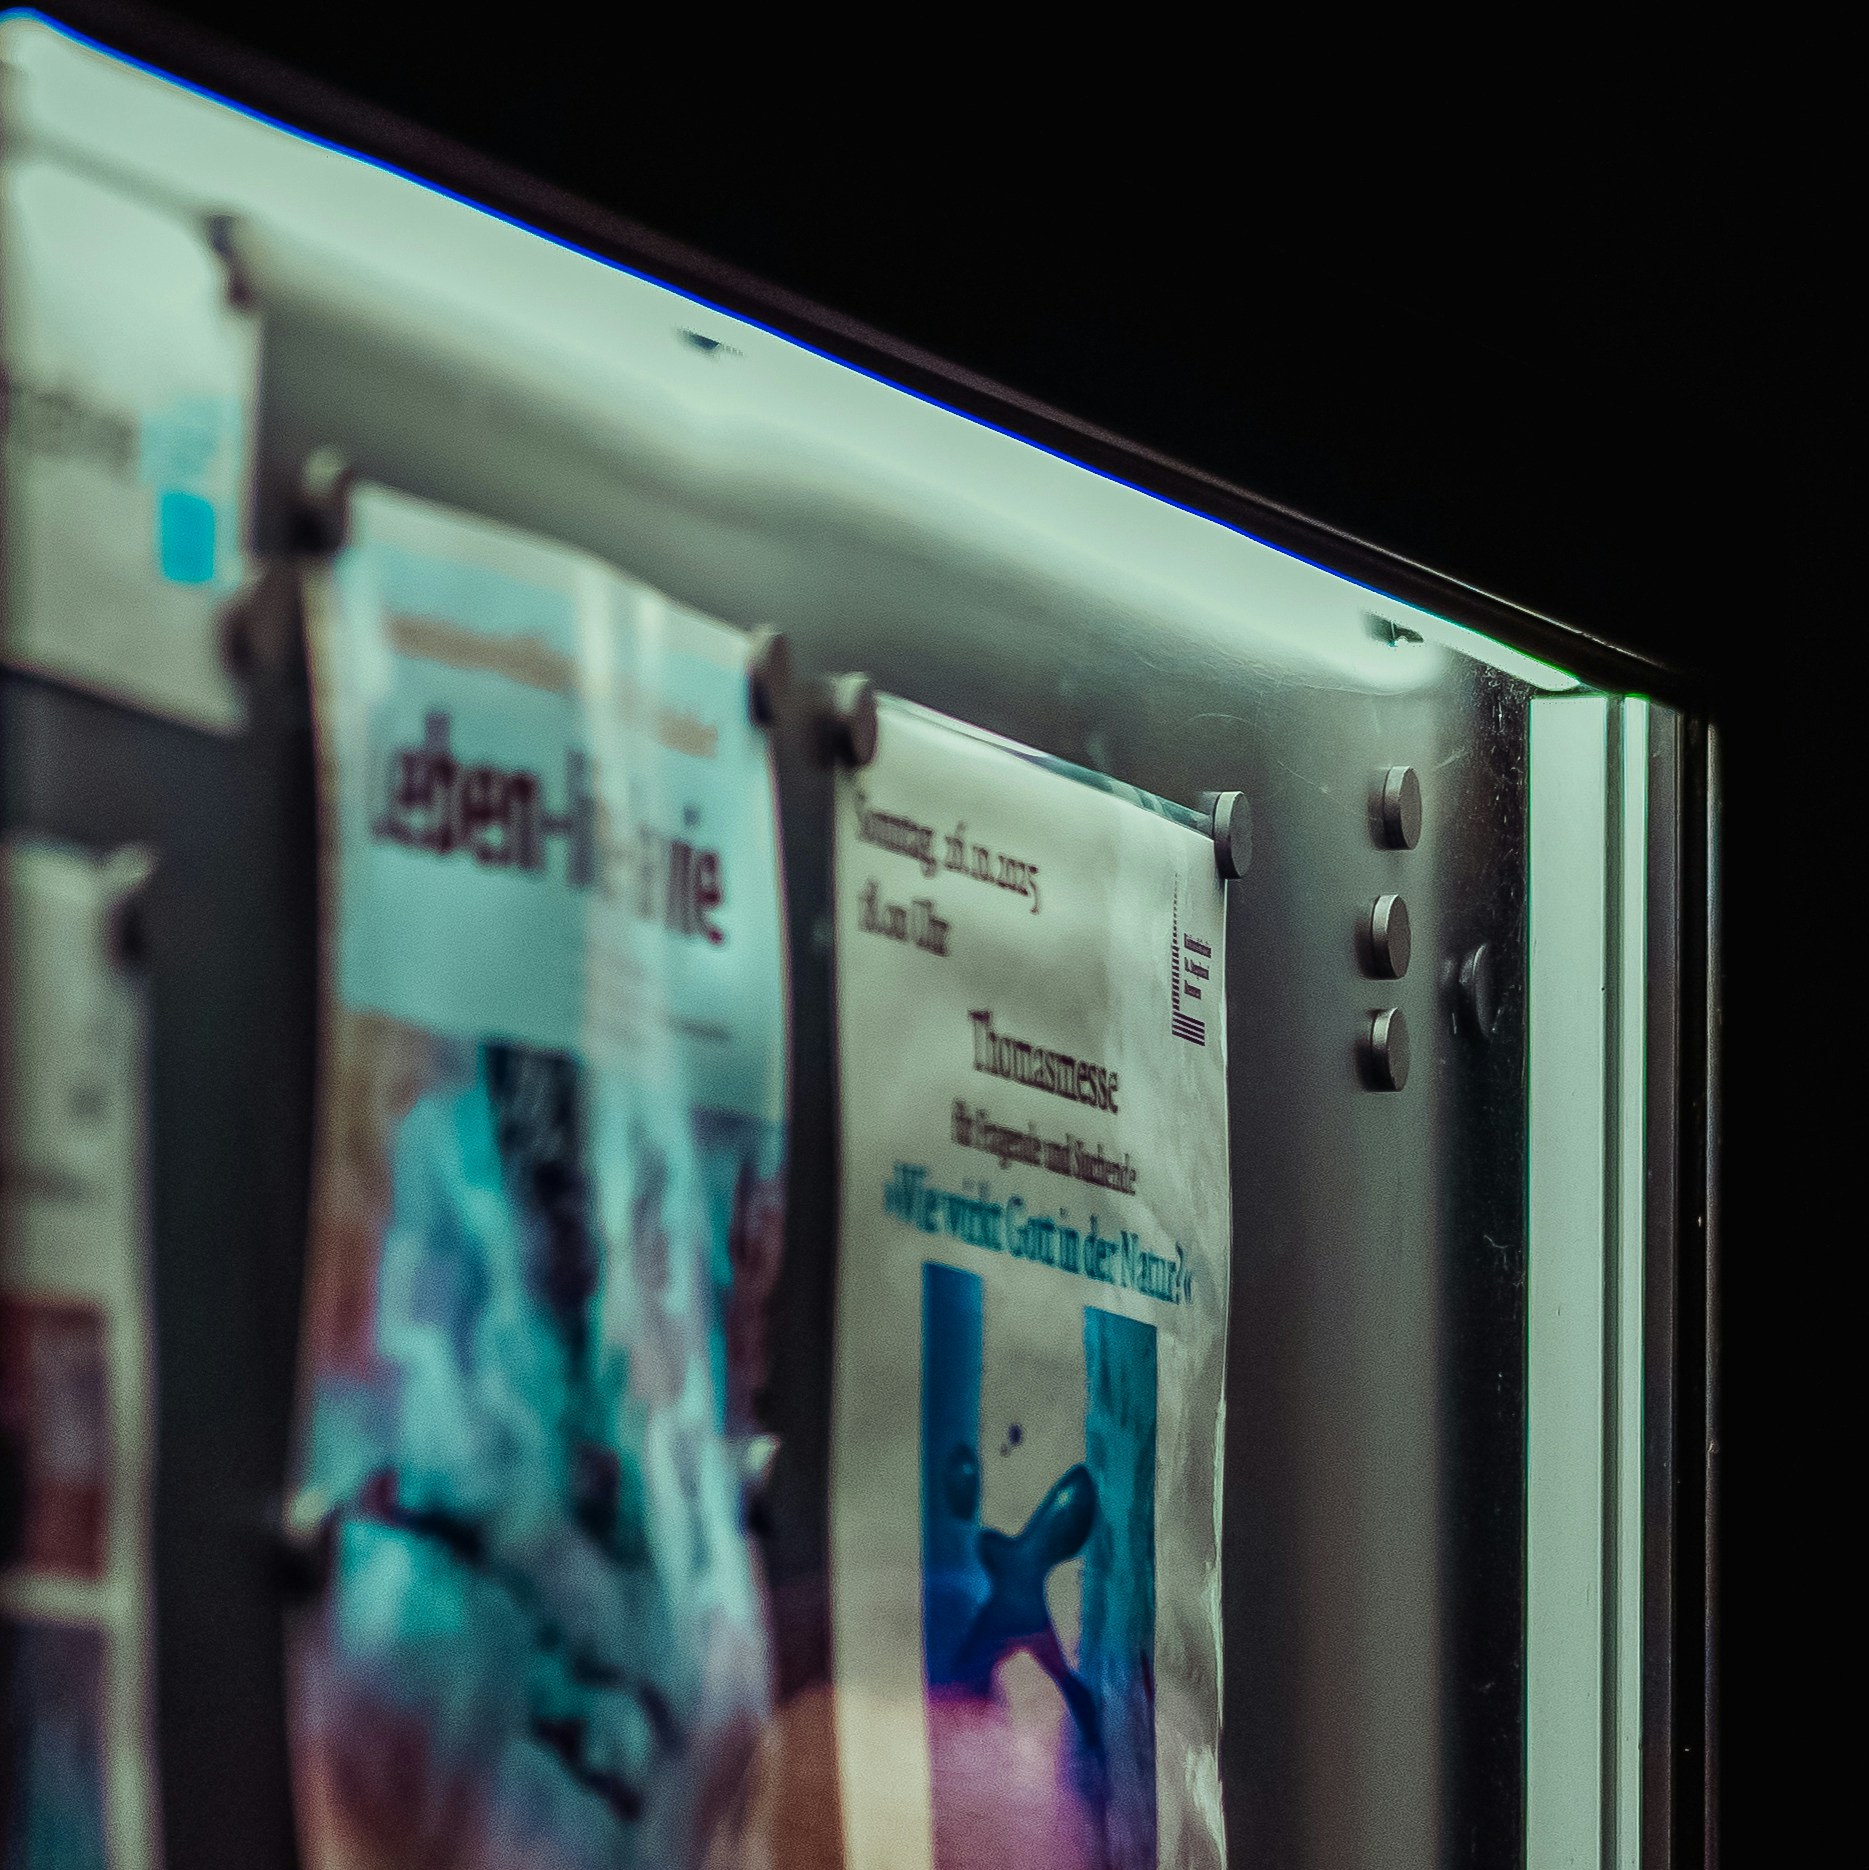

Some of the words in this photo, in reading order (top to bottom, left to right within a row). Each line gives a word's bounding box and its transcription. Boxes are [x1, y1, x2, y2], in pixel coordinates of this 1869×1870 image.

[967, 1010, 1119, 1115] Thomasmesse
[1057, 1206, 1082, 1276] in
[1083, 1212, 1119, 1285] der
